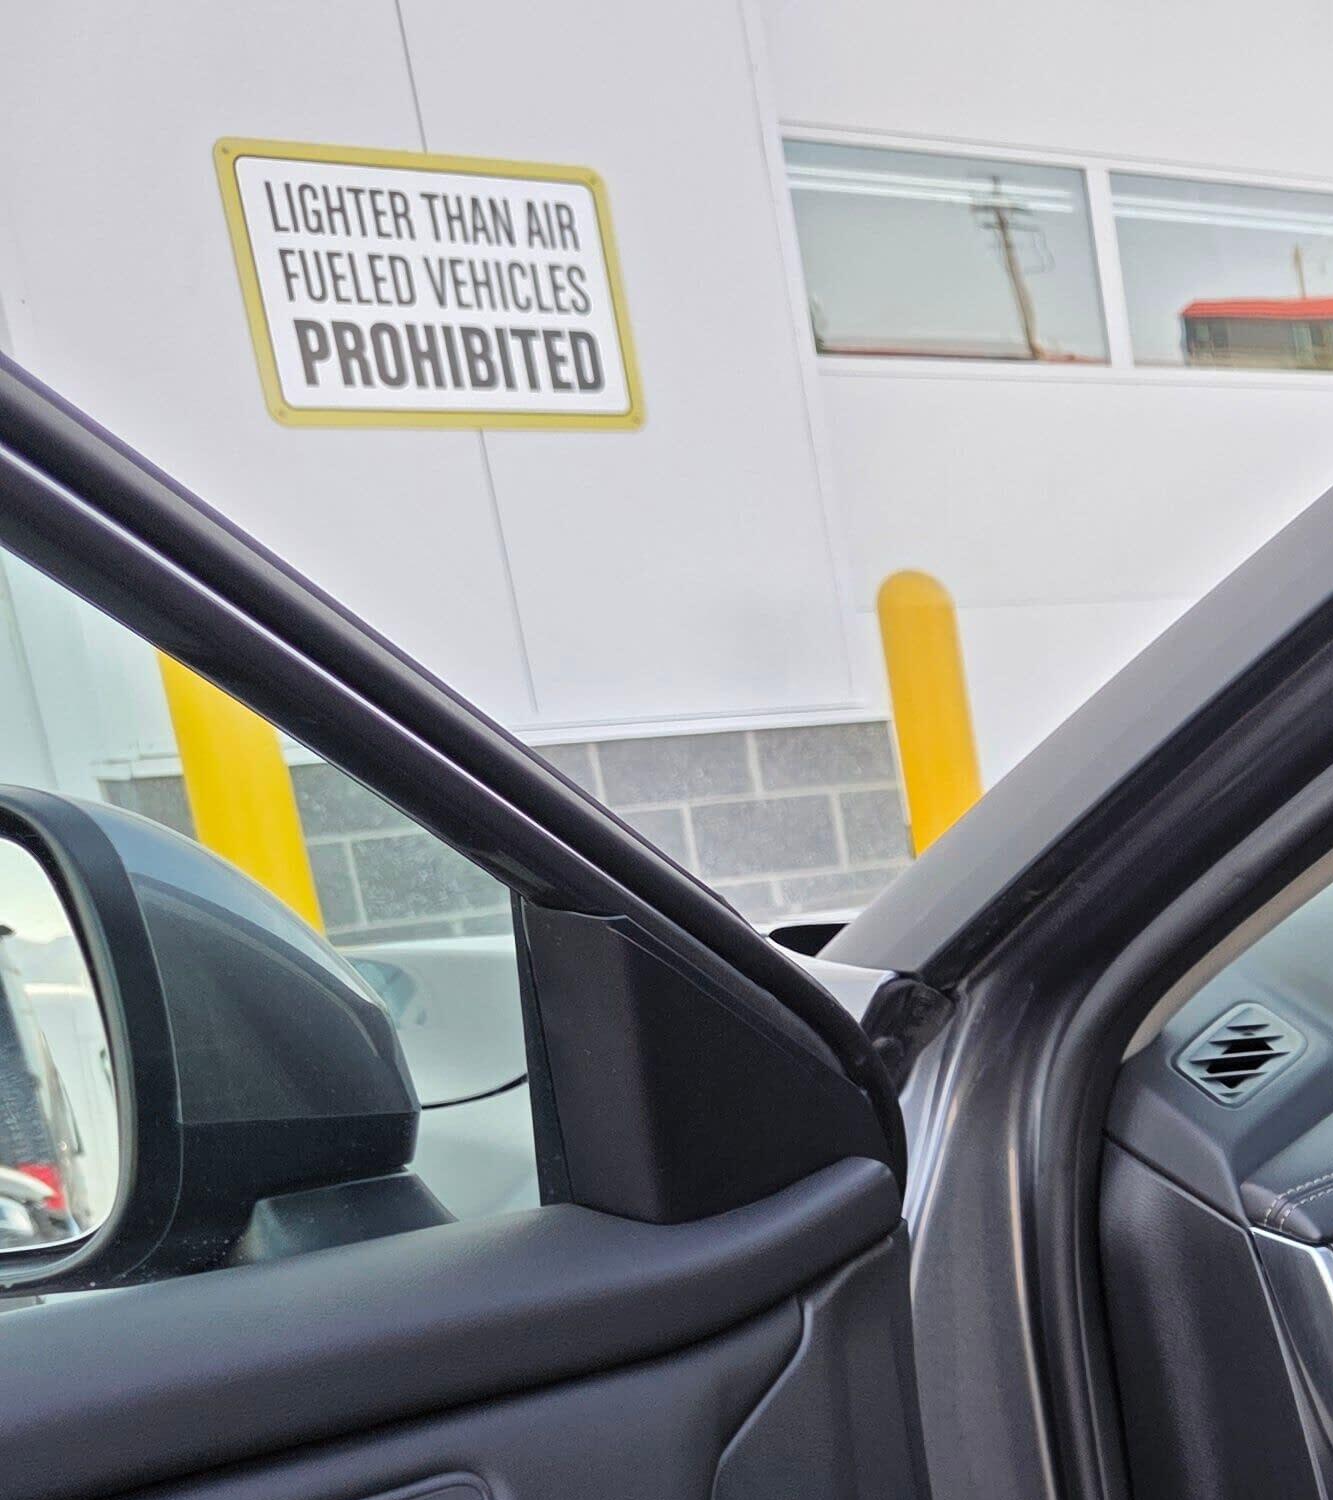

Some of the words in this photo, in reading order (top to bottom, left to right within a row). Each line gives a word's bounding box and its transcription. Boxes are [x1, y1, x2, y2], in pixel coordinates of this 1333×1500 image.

[264, 181, 416, 241] LIGHTER
[419, 192, 516, 248] THAN
[526, 201, 581, 252] AIR
[278, 248, 417, 307] FUELED
[423, 255, 592, 317] VEHICLES
[293, 318, 605, 392] PROHIBITED
